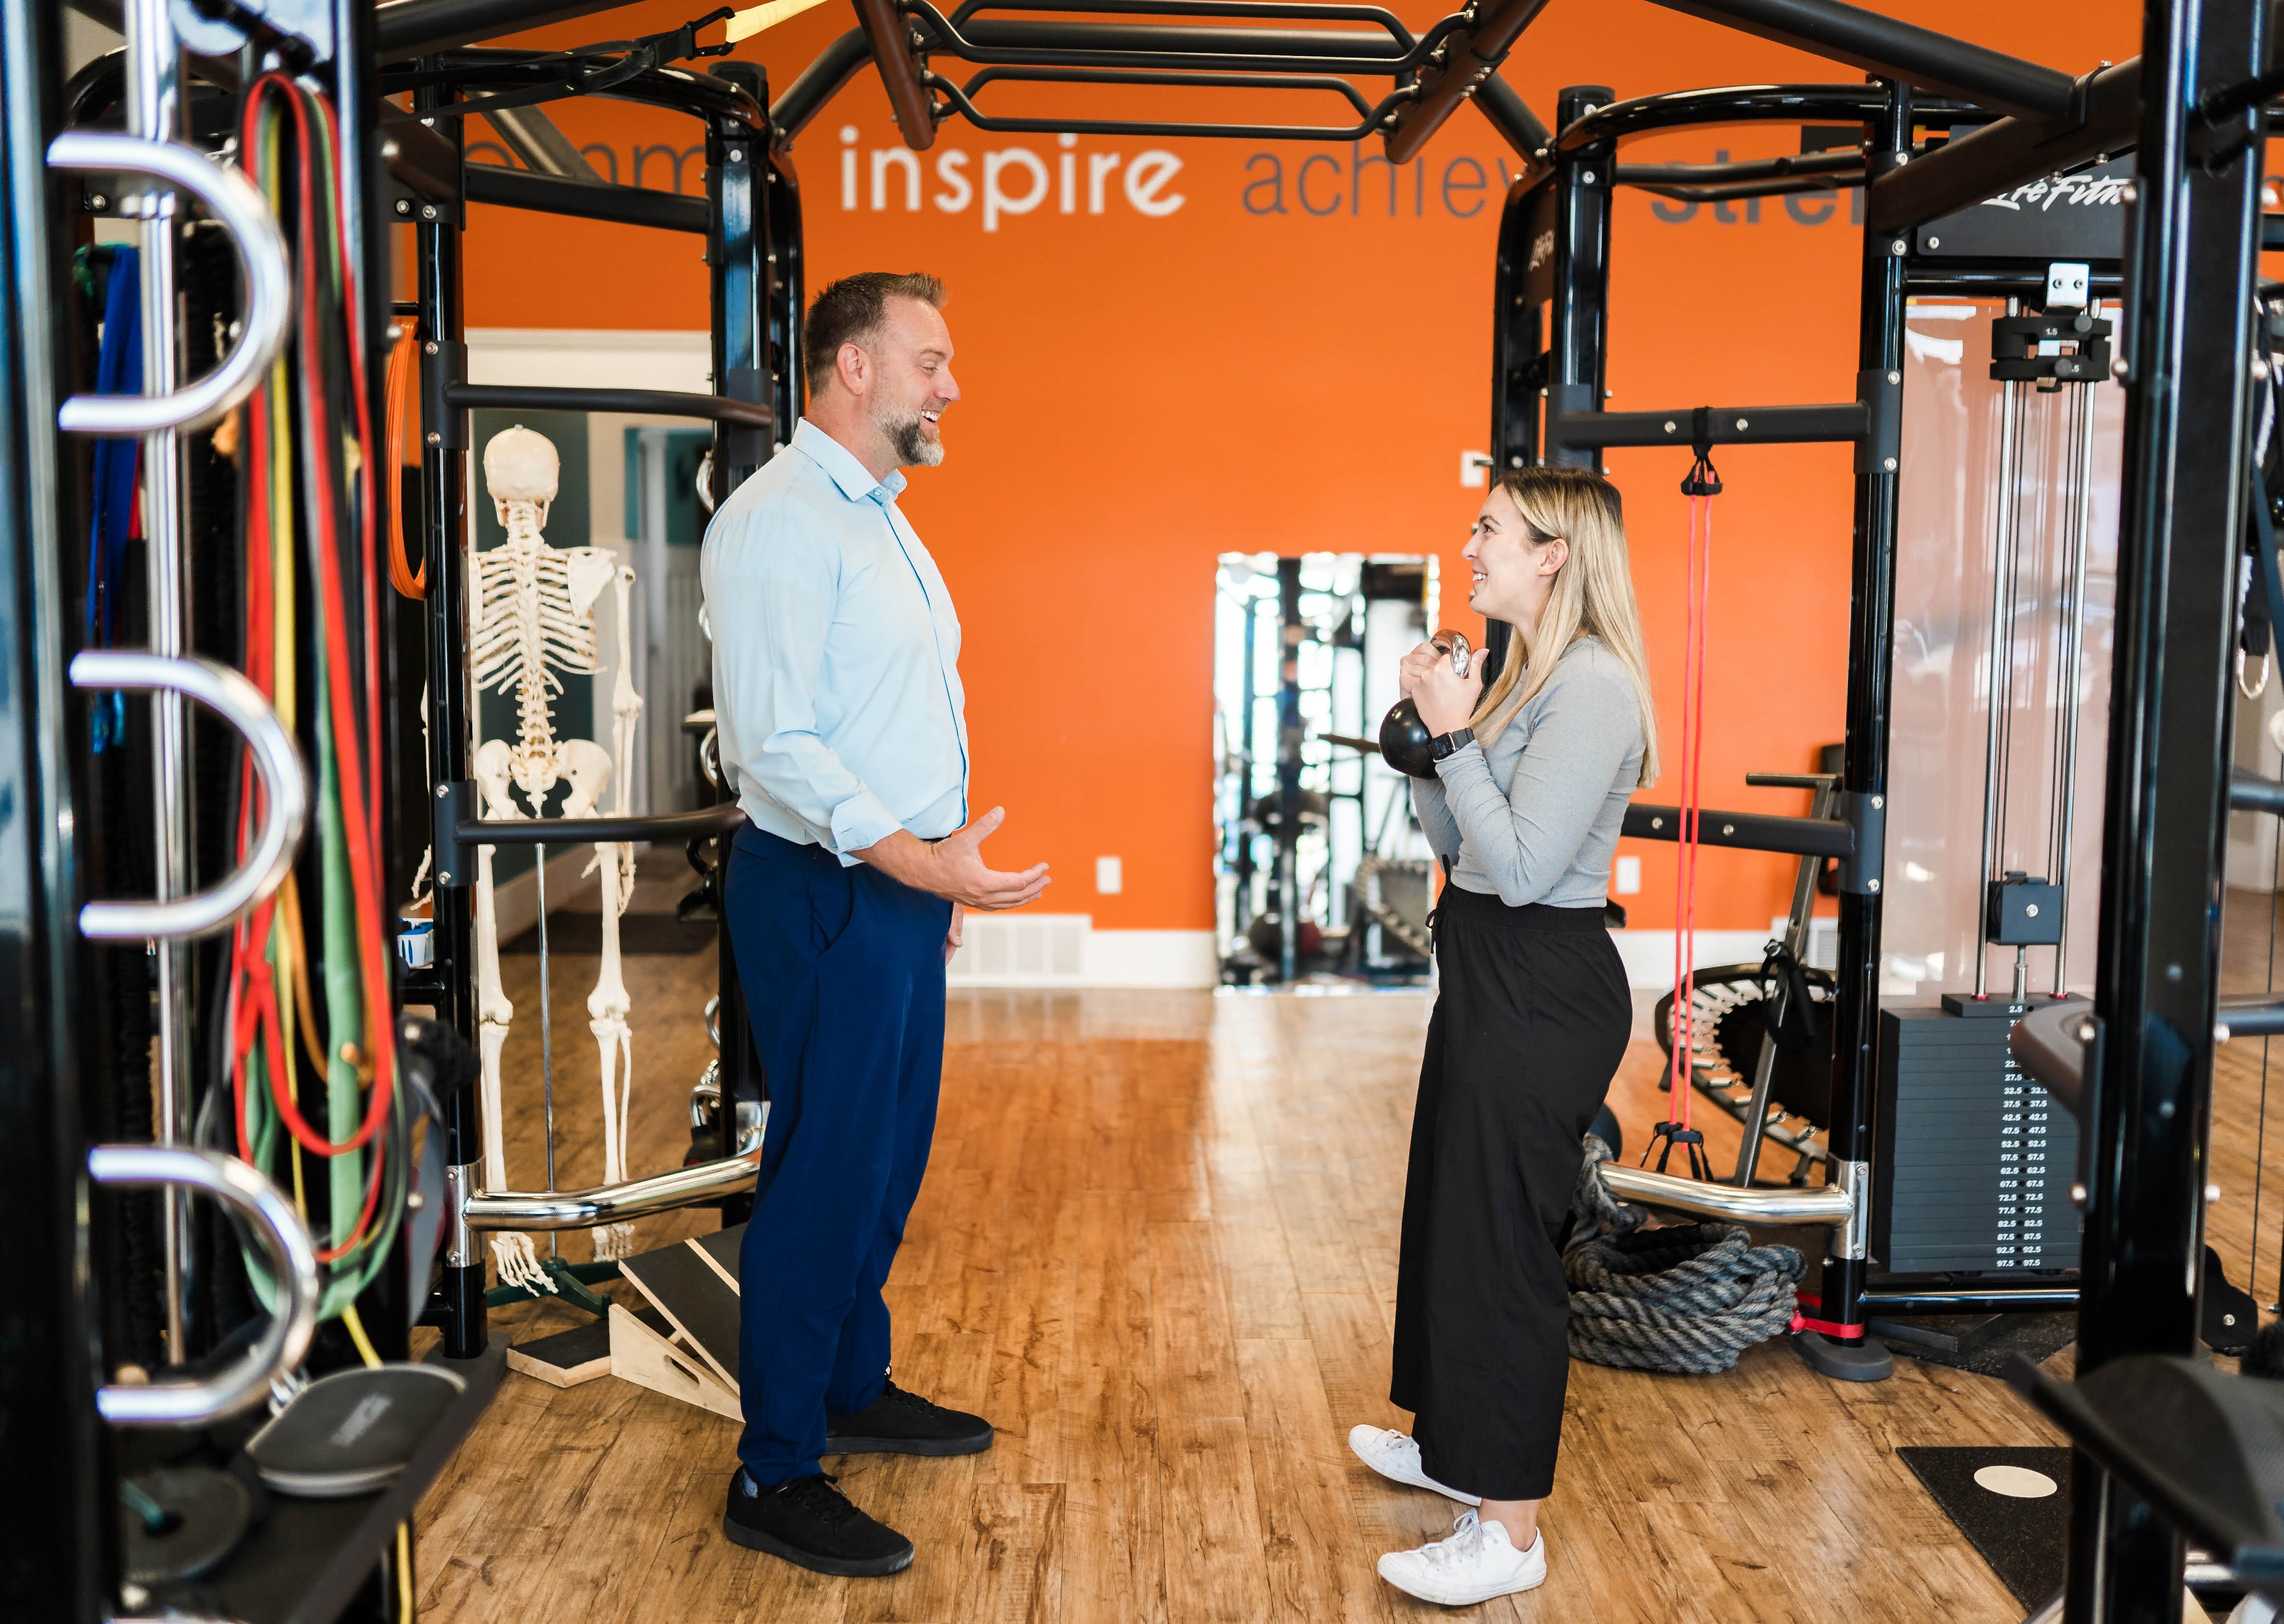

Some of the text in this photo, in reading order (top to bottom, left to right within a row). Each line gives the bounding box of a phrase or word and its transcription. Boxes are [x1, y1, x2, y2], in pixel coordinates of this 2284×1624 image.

[839, 125, 1186, 232] inspire
[2045, 327, 2058, 336] 1.5
[2071, 365, 2080, 373] .5
